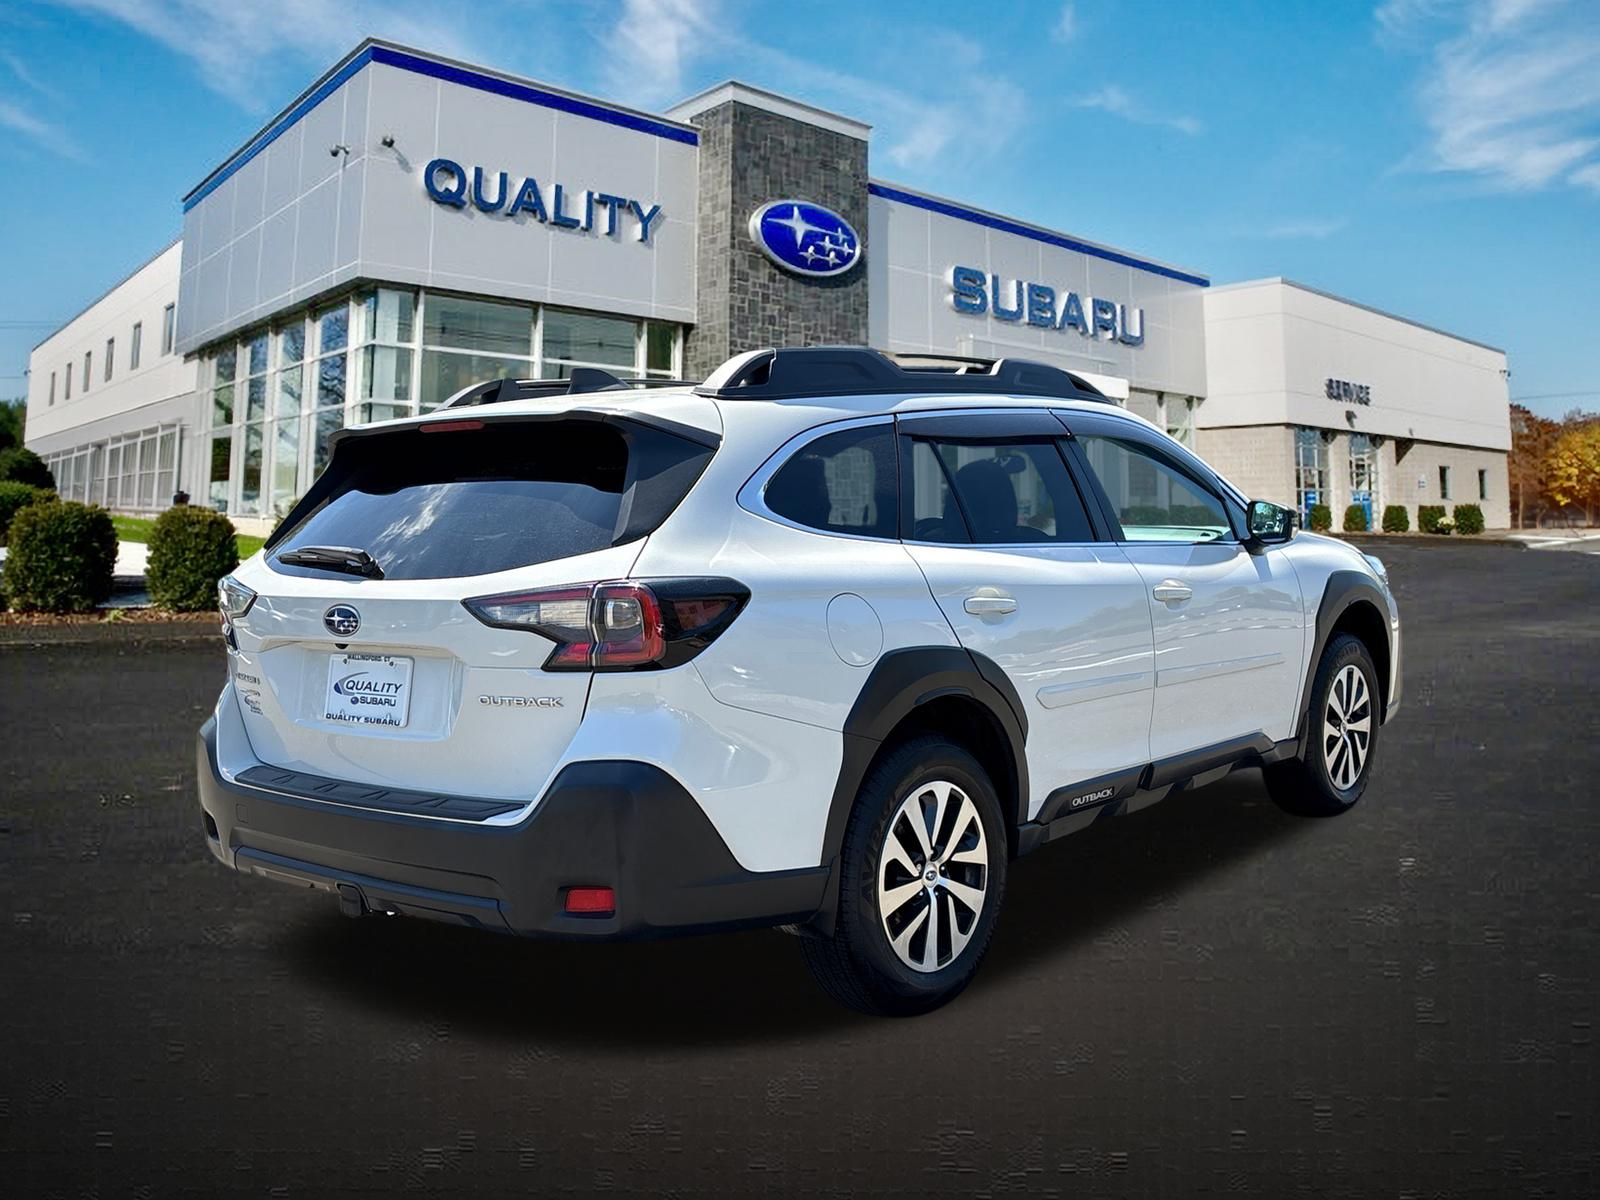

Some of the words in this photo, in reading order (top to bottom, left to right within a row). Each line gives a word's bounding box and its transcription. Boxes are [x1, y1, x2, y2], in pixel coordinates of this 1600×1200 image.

[423, 158, 661, 243] QUALITY
[949, 264, 1145, 346] SUBARU
[1324, 377, 1371, 406] SERVICE
[345, 679, 403, 694] QUALITY
[359, 695, 397, 707] SUBARU
[478, 694, 565, 708] OUTBACK
[325, 712, 361, 723] QUALITY
[364, 716, 401, 727] SUBARU
[1072, 787, 1114, 807] OUTBACK
